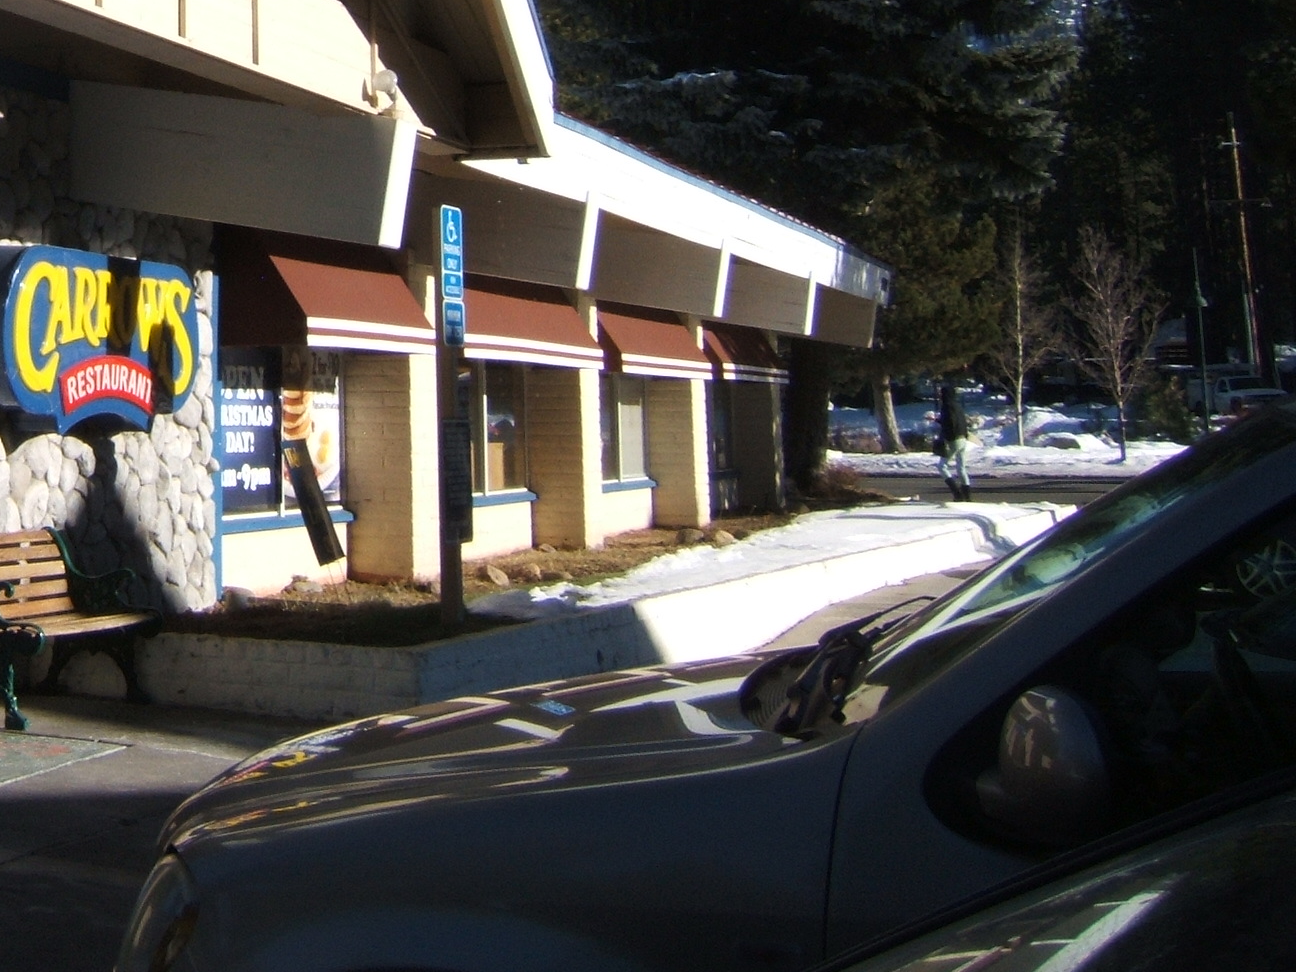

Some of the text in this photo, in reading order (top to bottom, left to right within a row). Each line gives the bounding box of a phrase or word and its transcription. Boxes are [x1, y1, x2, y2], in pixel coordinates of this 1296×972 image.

[67, 364, 153, 404] RESTAURANT
[220, 364, 265, 401] PEN
[225, 431, 255, 454] DAY!
